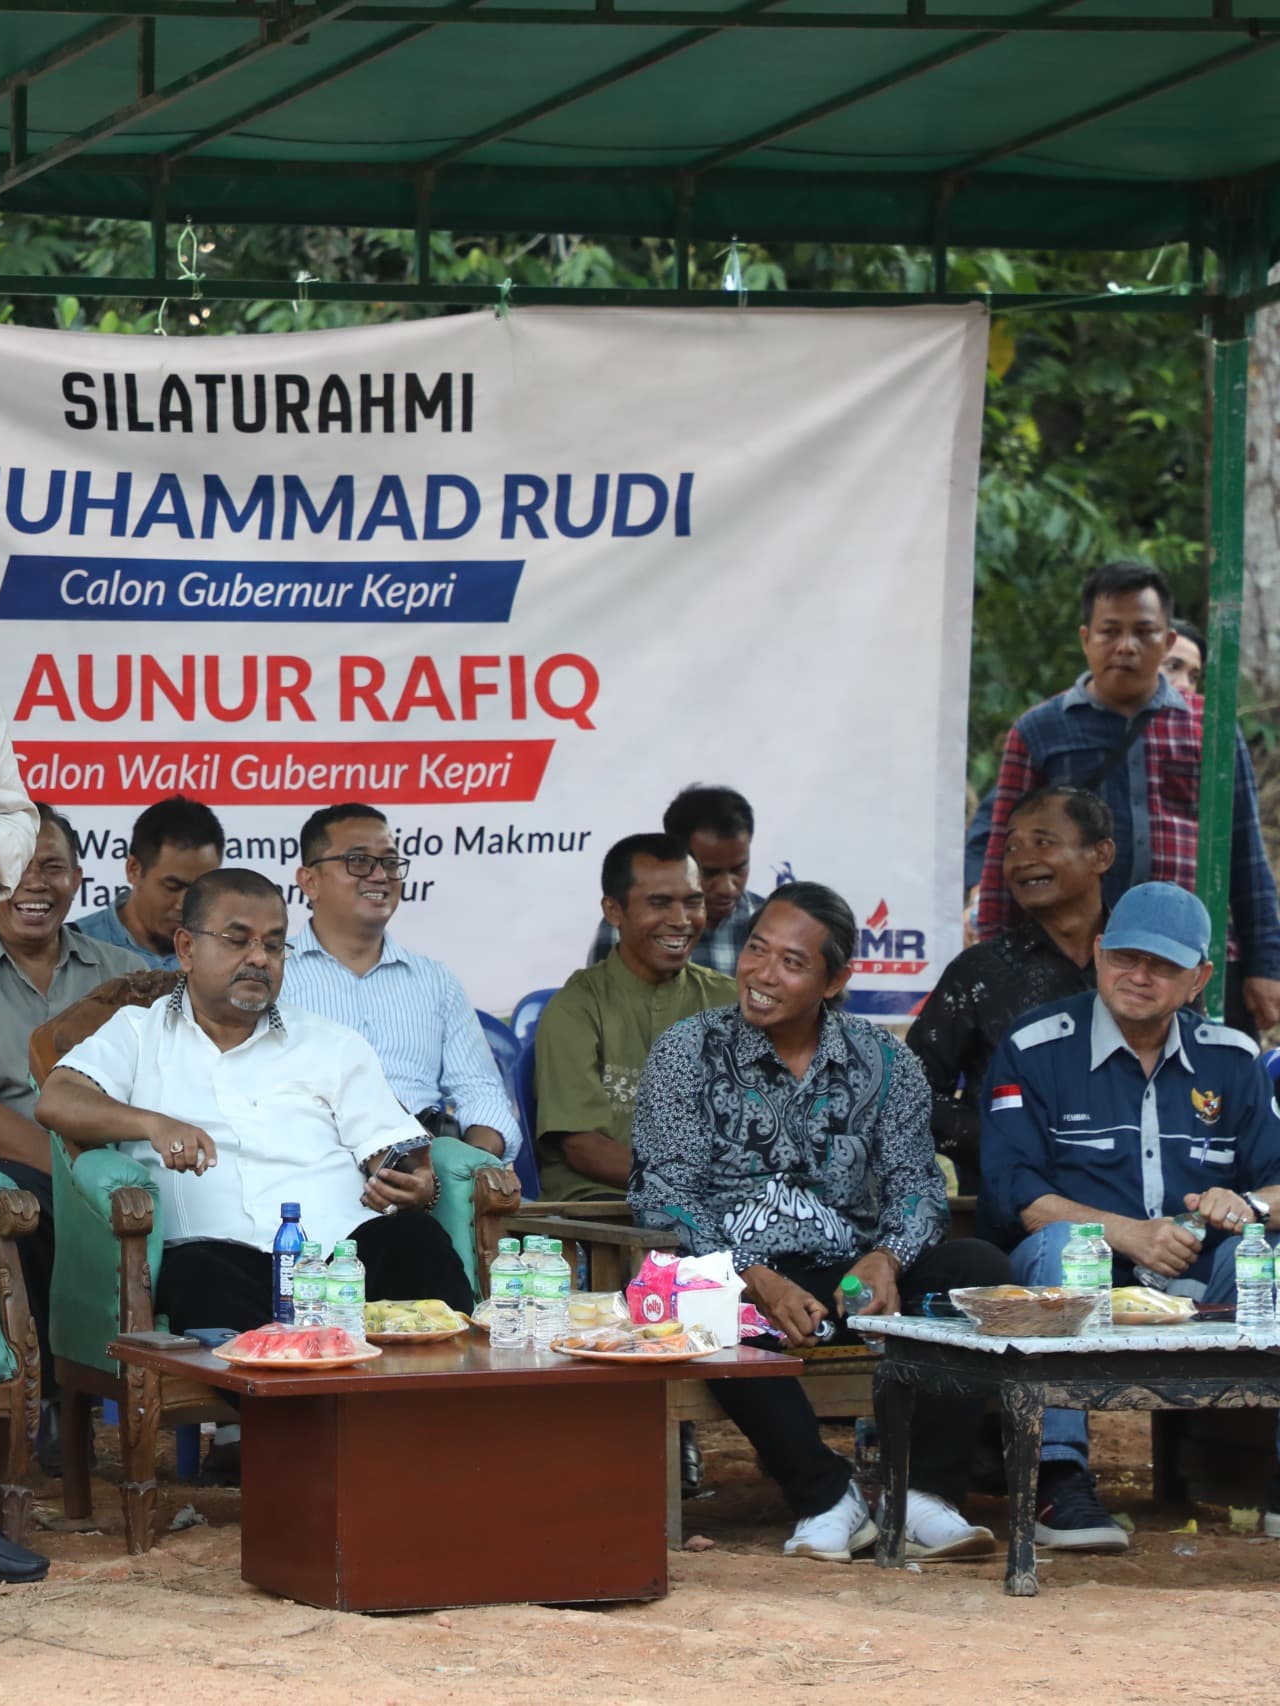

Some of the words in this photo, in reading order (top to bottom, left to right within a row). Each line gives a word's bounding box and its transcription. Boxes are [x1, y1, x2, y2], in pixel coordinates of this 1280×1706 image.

[62, 372, 473, 433] SILATURAHMI
[500, 472, 695, 539] RUDI
[60, 569, 166, 607] Calon
[178, 571, 353, 608] Gubernur
[361, 573, 457, 615] Kepri
[13, 653, 316, 722] AUNUR
[339, 653, 600, 730] RAFIQ
[117, 753, 219, 790] Wakil
[230, 754, 408, 790] Gubernur
[419, 753, 512, 796] Kepri
[394, 827, 443, 857] ido
[454, 825, 591, 855] Makmur
[853, 929, 925, 959] MR
[645, 1298, 662, 1316] jolly
